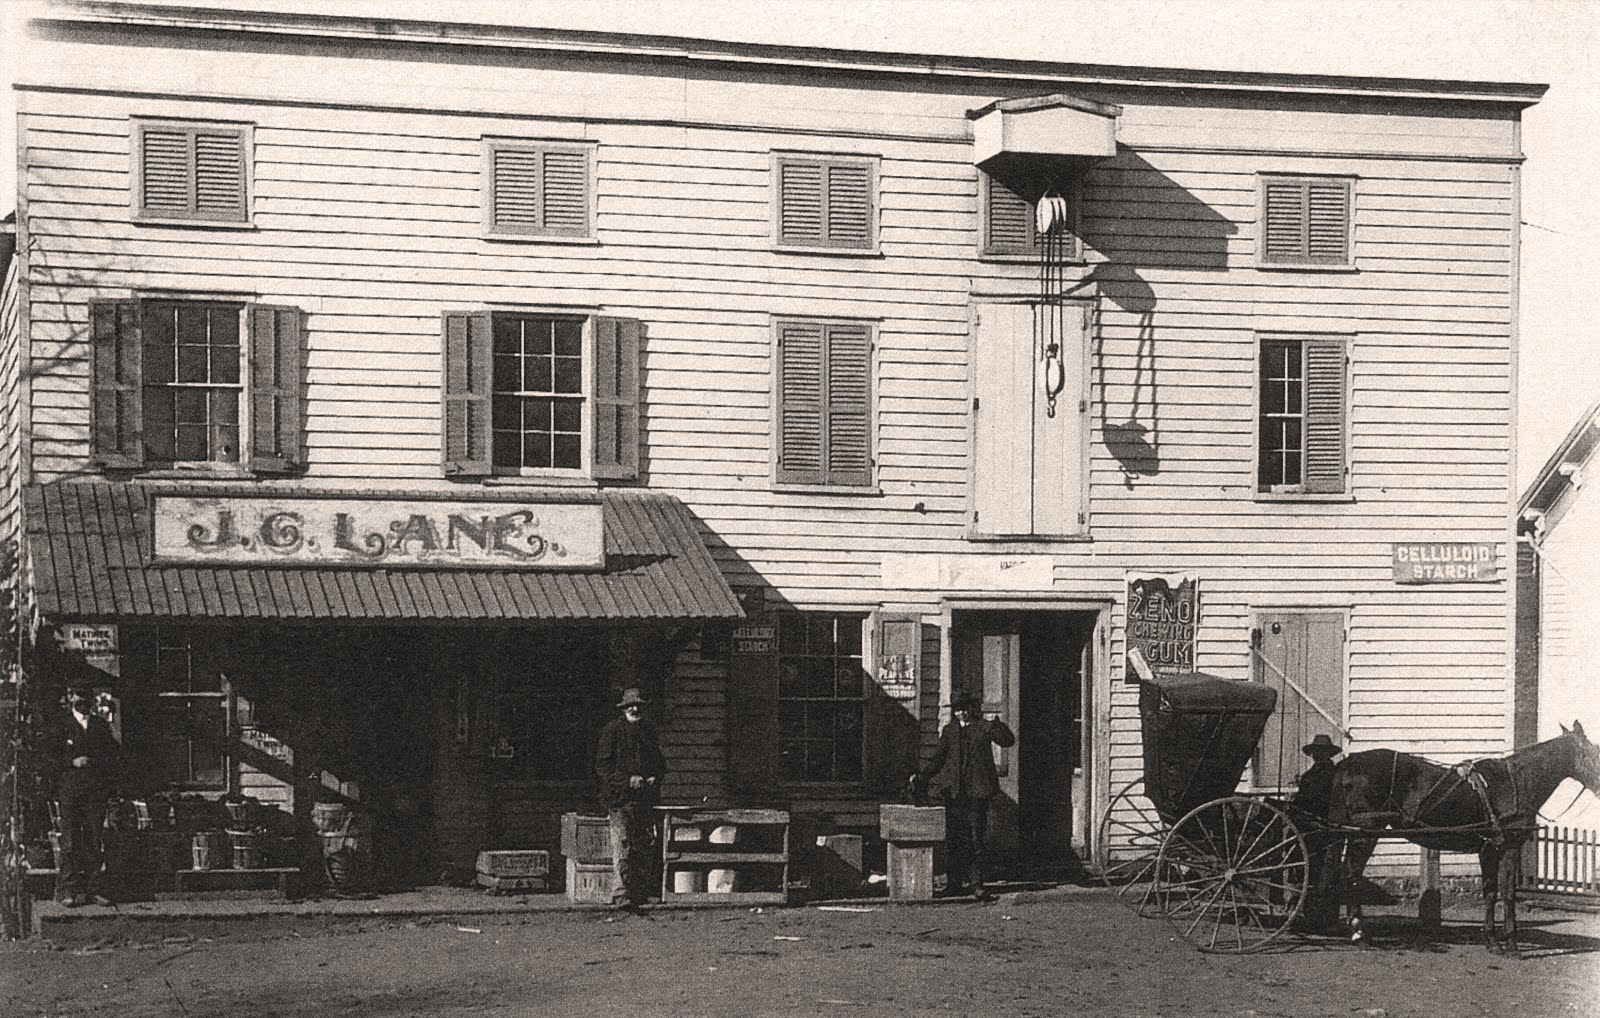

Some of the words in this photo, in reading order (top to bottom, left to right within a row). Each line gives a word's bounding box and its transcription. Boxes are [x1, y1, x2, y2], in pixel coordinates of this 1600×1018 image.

[333, 509, 567, 562] LANE.
[1397, 545, 1490, 562] CELLULOID
[1413, 564, 1478, 579] STARCH
[1128, 593, 1192, 623] ZENO
[1134, 622, 1192, 640] CHEWING
[1145, 640, 1190, 664] GUM
